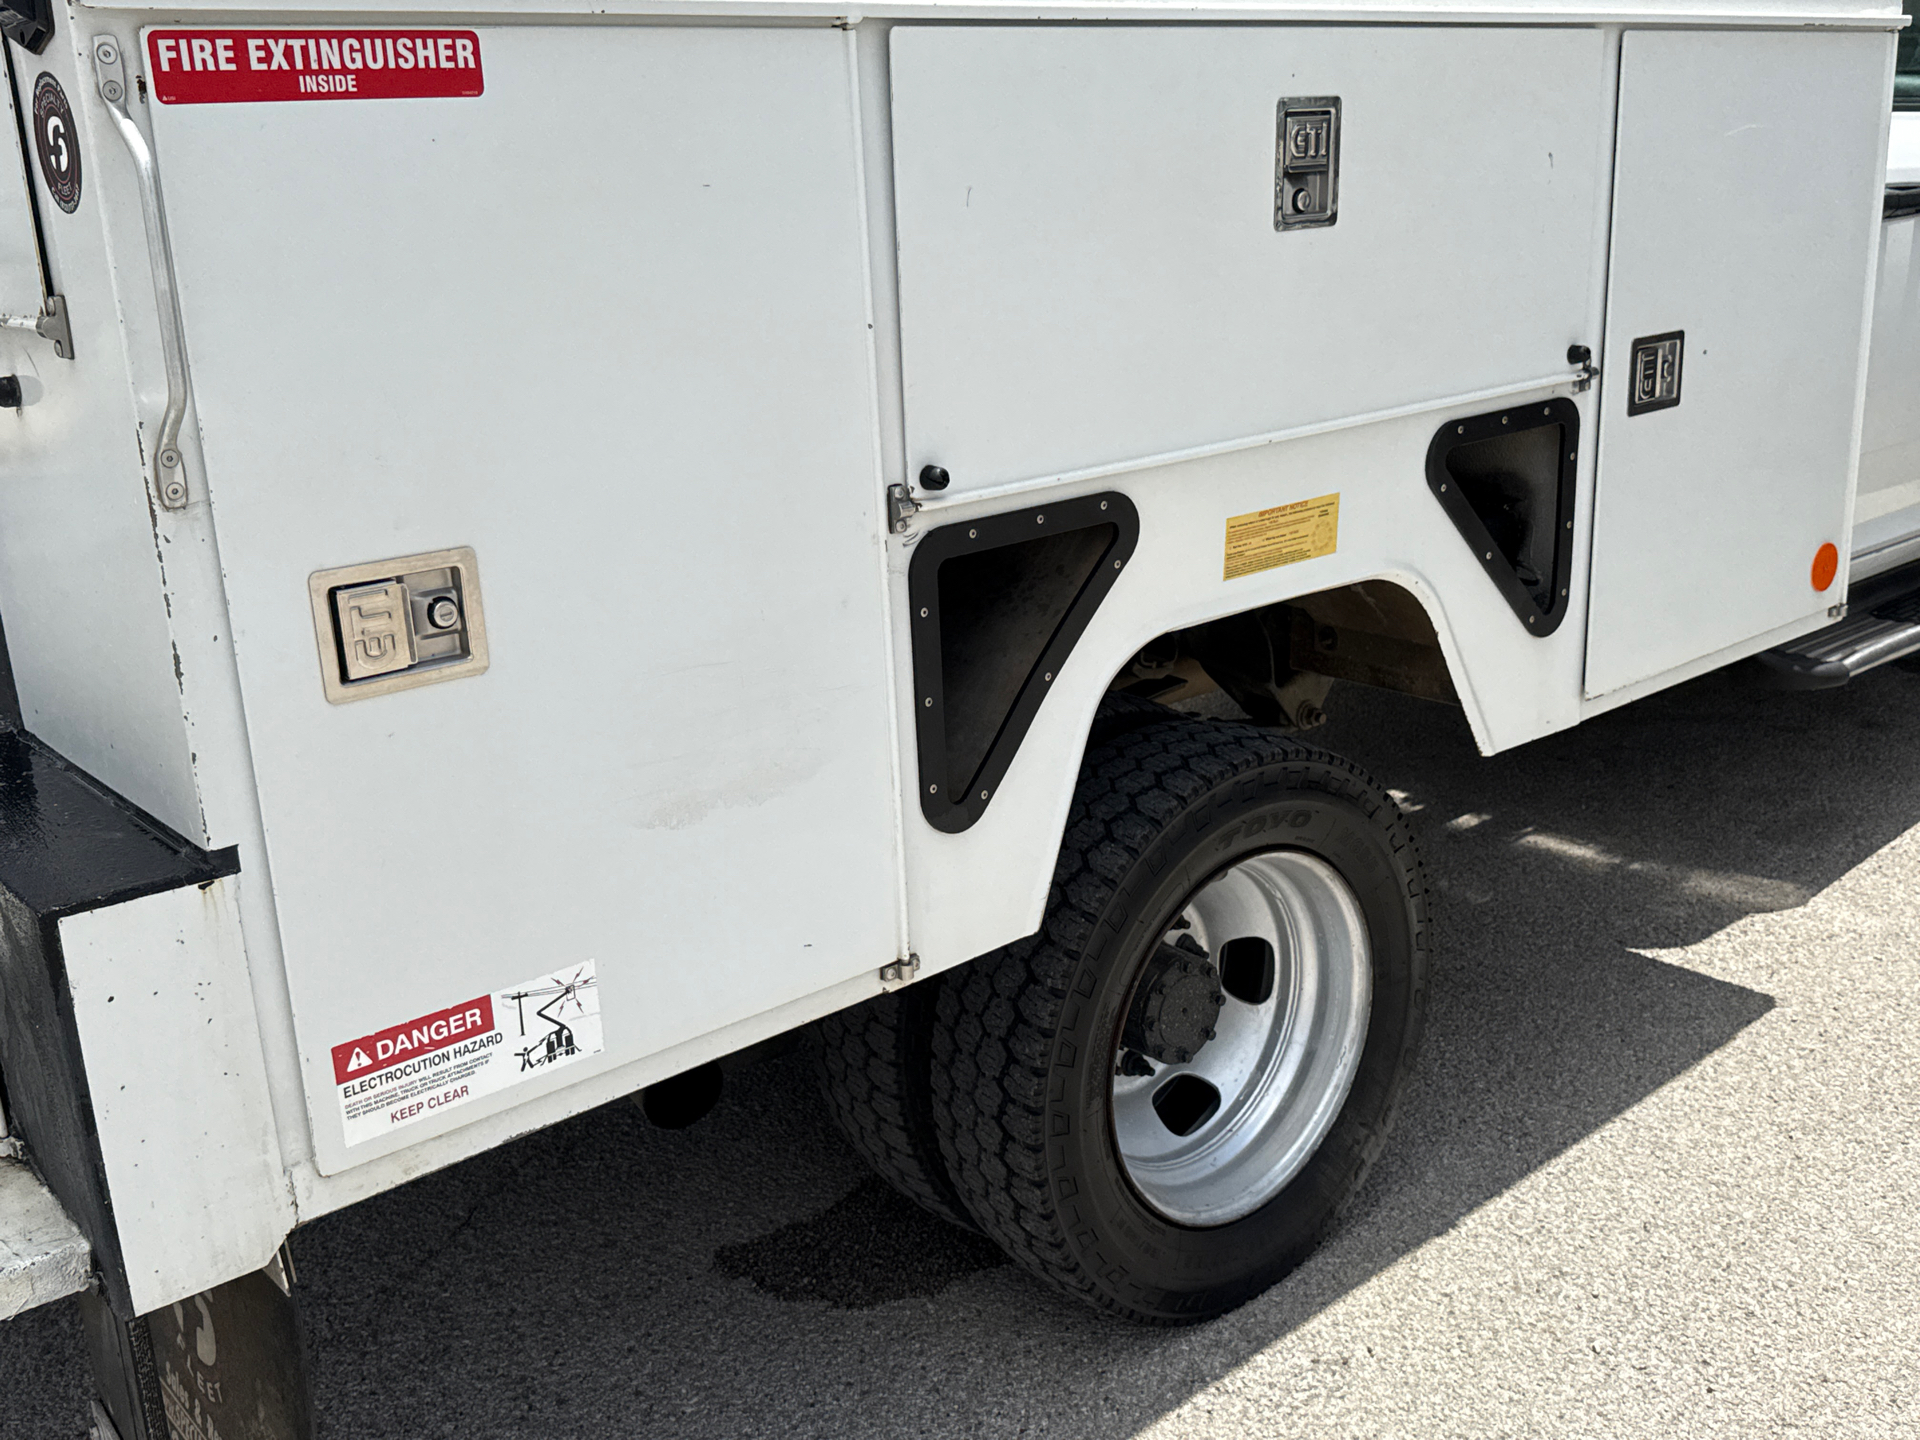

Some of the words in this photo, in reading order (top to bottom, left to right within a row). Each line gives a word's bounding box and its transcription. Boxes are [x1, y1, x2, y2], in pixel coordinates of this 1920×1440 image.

[157, 38, 237, 72] FIRE
[247, 37, 476, 71] EXTINGUISHER
[299, 74, 358, 93] INSIDE
[1258, 503, 1289, 518] IMPORTANT
[1289, 500, 1309, 511] NOTICE
[1218, 808, 1313, 850] TOYO
[376, 1008, 483, 1061] DANGER
[343, 1050, 451, 1099] ELECTROCUTION
[453, 1032, 503, 1060] HAZARD
[344, 1100, 363, 1110] DEATH
[373, 1087, 397, 1099] SERIOUS
[398, 1079, 417, 1090] INJURY
[418, 1074, 431, 1083] WILL
[433, 1066, 452, 1077] RESULT
[453, 1060, 469, 1070] FROM
[469, 1051, 493, 1064] CONTACT
[346, 1105, 360, 1115] WITH
[361, 1102, 373, 1110] THIS
[400, 1085, 419, 1095] TRUCK
[428, 1074, 447, 1085] TRUCK
[447, 1061, 484, 1078] ATTACHMENTS
[347, 1111, 361, 1121] THEY
[362, 1103, 385, 1116] SHOULD
[386, 1094, 409, 1107] BECOME
[410, 1080, 449, 1098] ELECTRICALLY
[390, 1101, 425, 1124] KEEP
[427, 1085, 470, 1109] CLEAR
[165, 1361, 190, 1410] Sales
